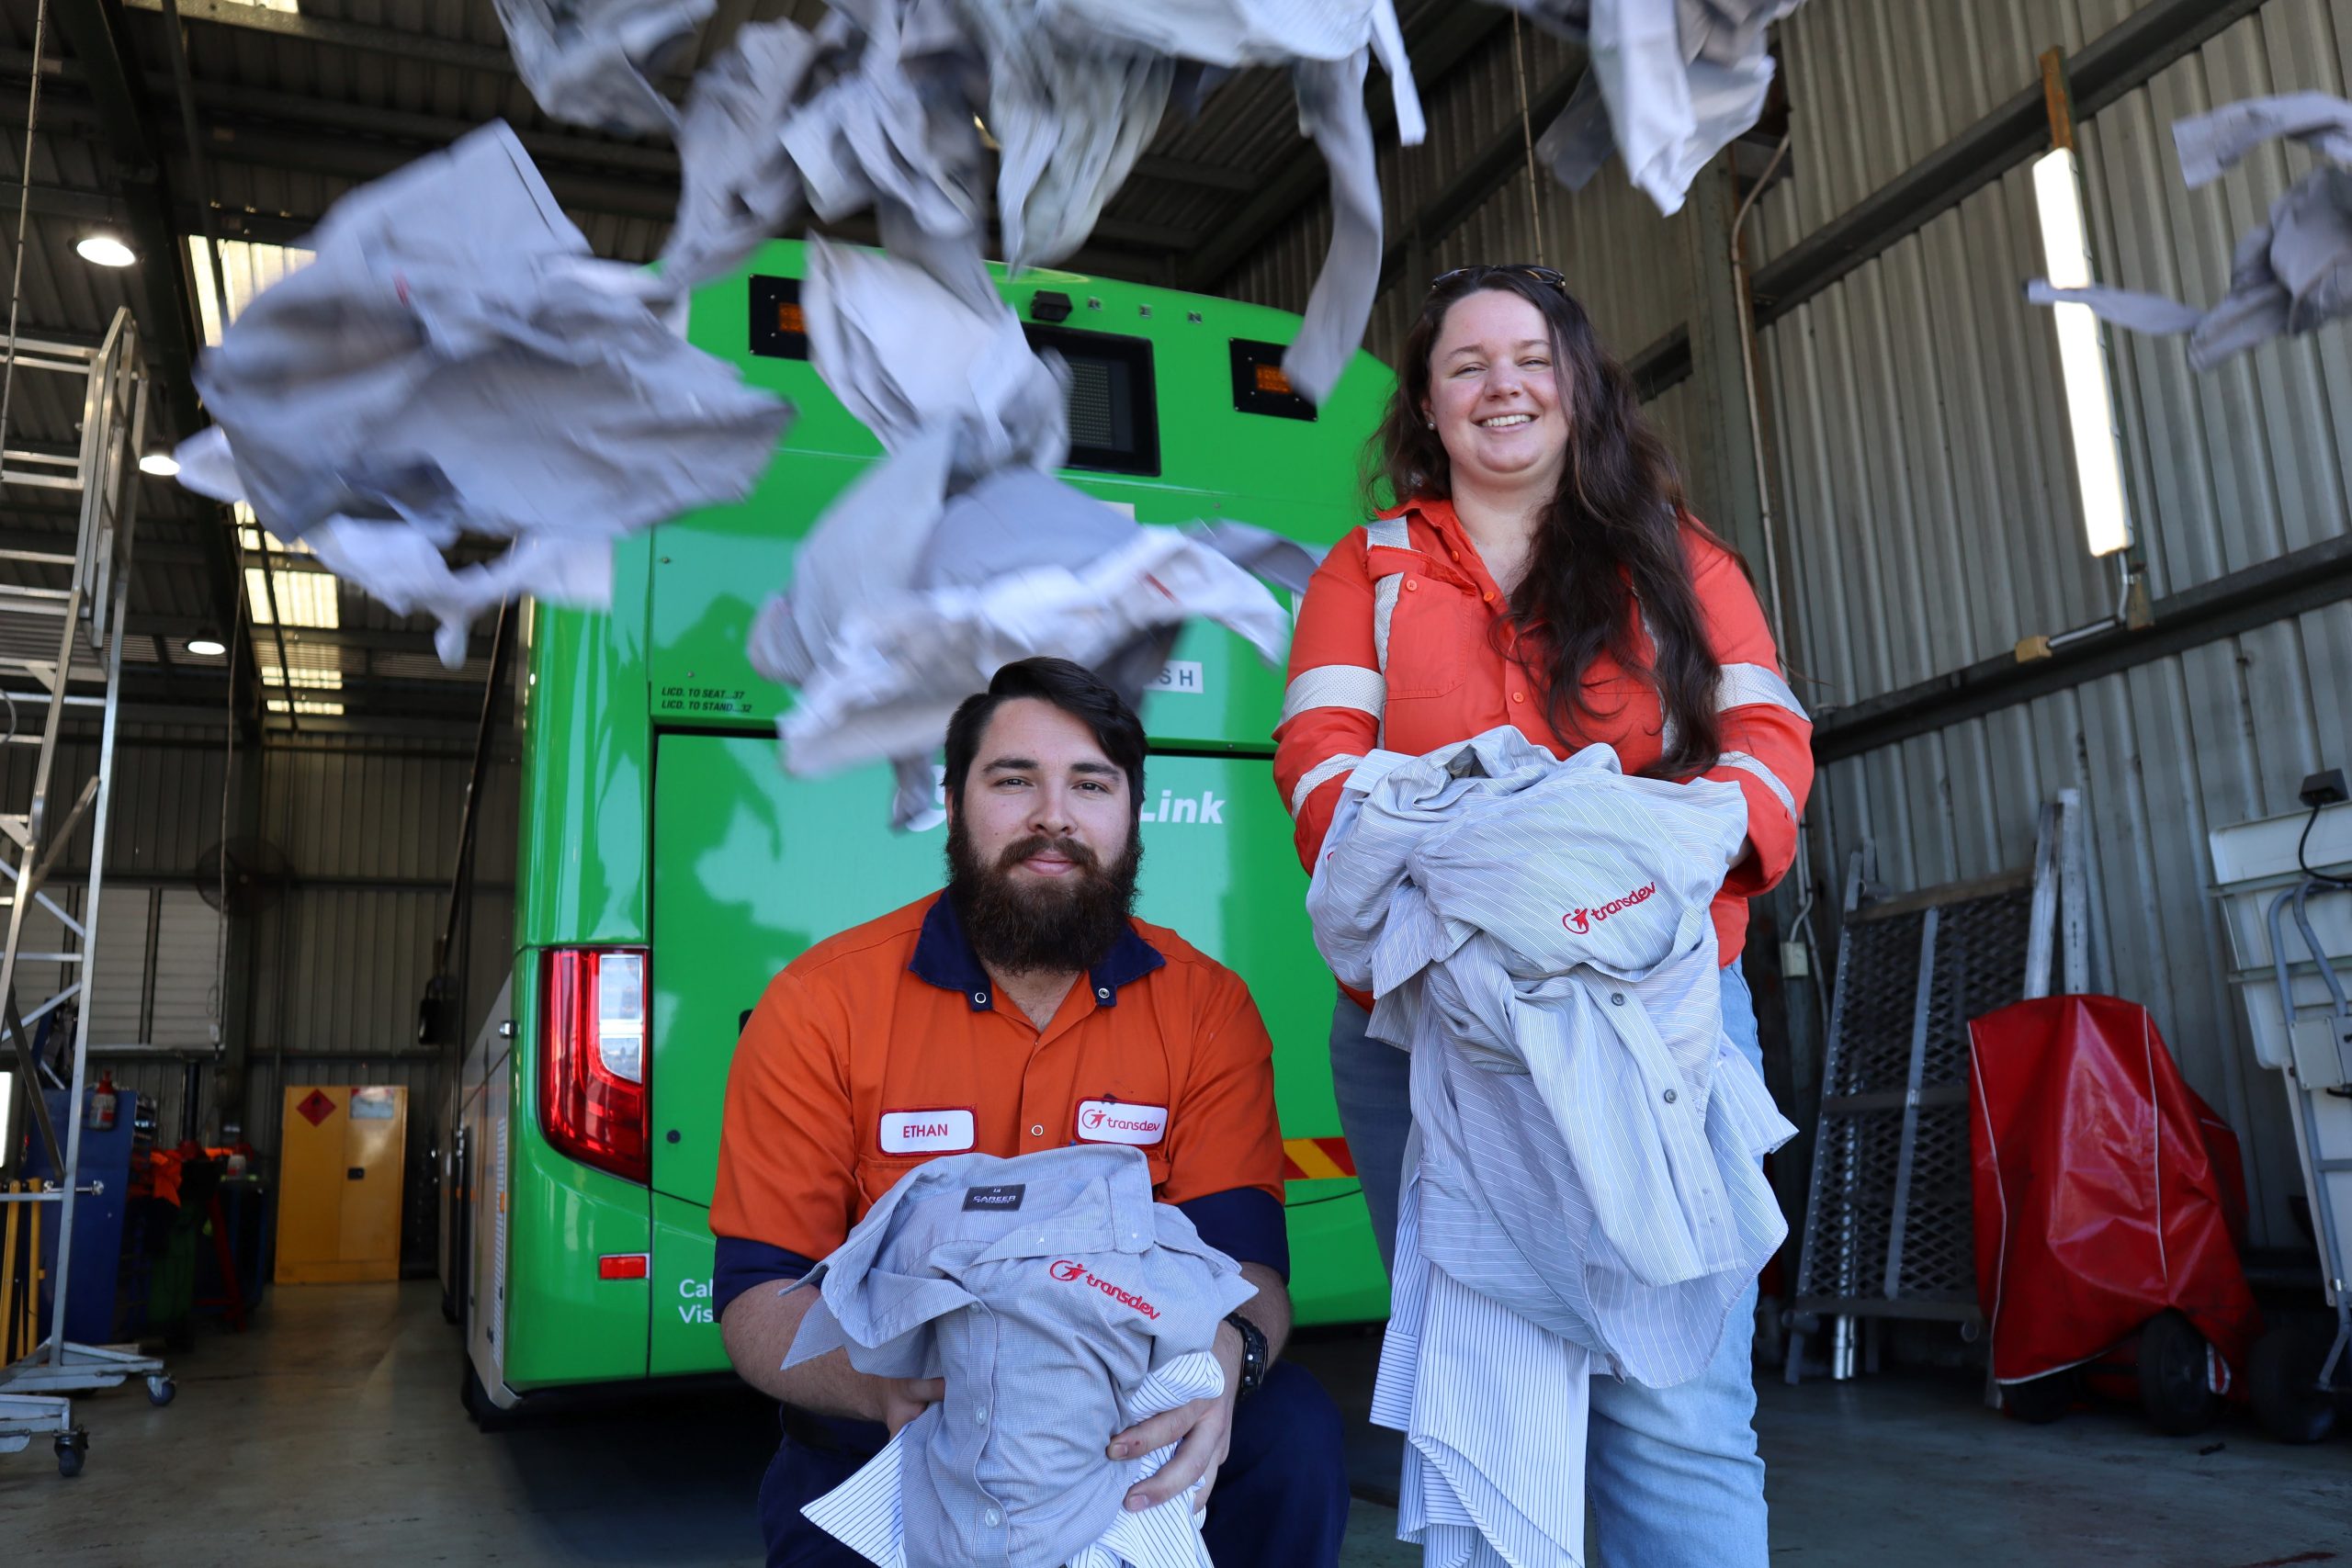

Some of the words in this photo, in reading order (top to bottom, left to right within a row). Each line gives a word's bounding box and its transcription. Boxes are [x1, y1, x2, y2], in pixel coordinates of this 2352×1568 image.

[662, 686, 684, 697] LICD.
[688, 688, 700, 697] TO
[662, 700, 684, 710] LICD.
[688, 701, 700, 710] TO
[1590, 881, 1657, 921] transdev
[902, 1123, 949, 1139] ETHAN
[1106, 1117, 1161, 1132] transdev
[1086, 1273, 1161, 1321] transdev
